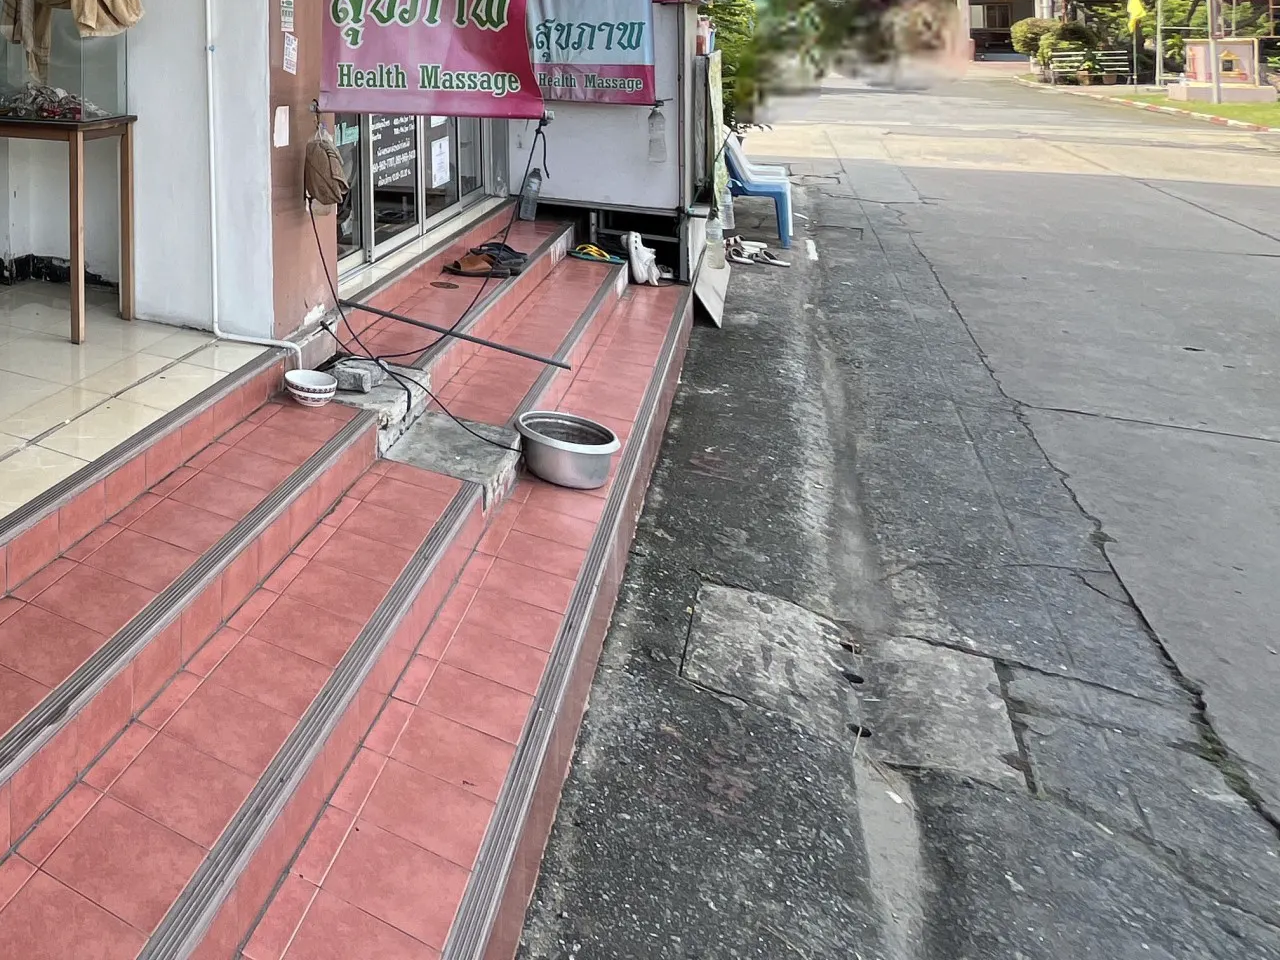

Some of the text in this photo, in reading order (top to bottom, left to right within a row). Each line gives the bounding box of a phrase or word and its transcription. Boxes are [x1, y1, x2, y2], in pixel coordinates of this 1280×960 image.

[534, 19, 646, 62] สุขภาพ
[336, 63, 521, 97] Health Massage
[538, 73, 643, 91] Health Massage
